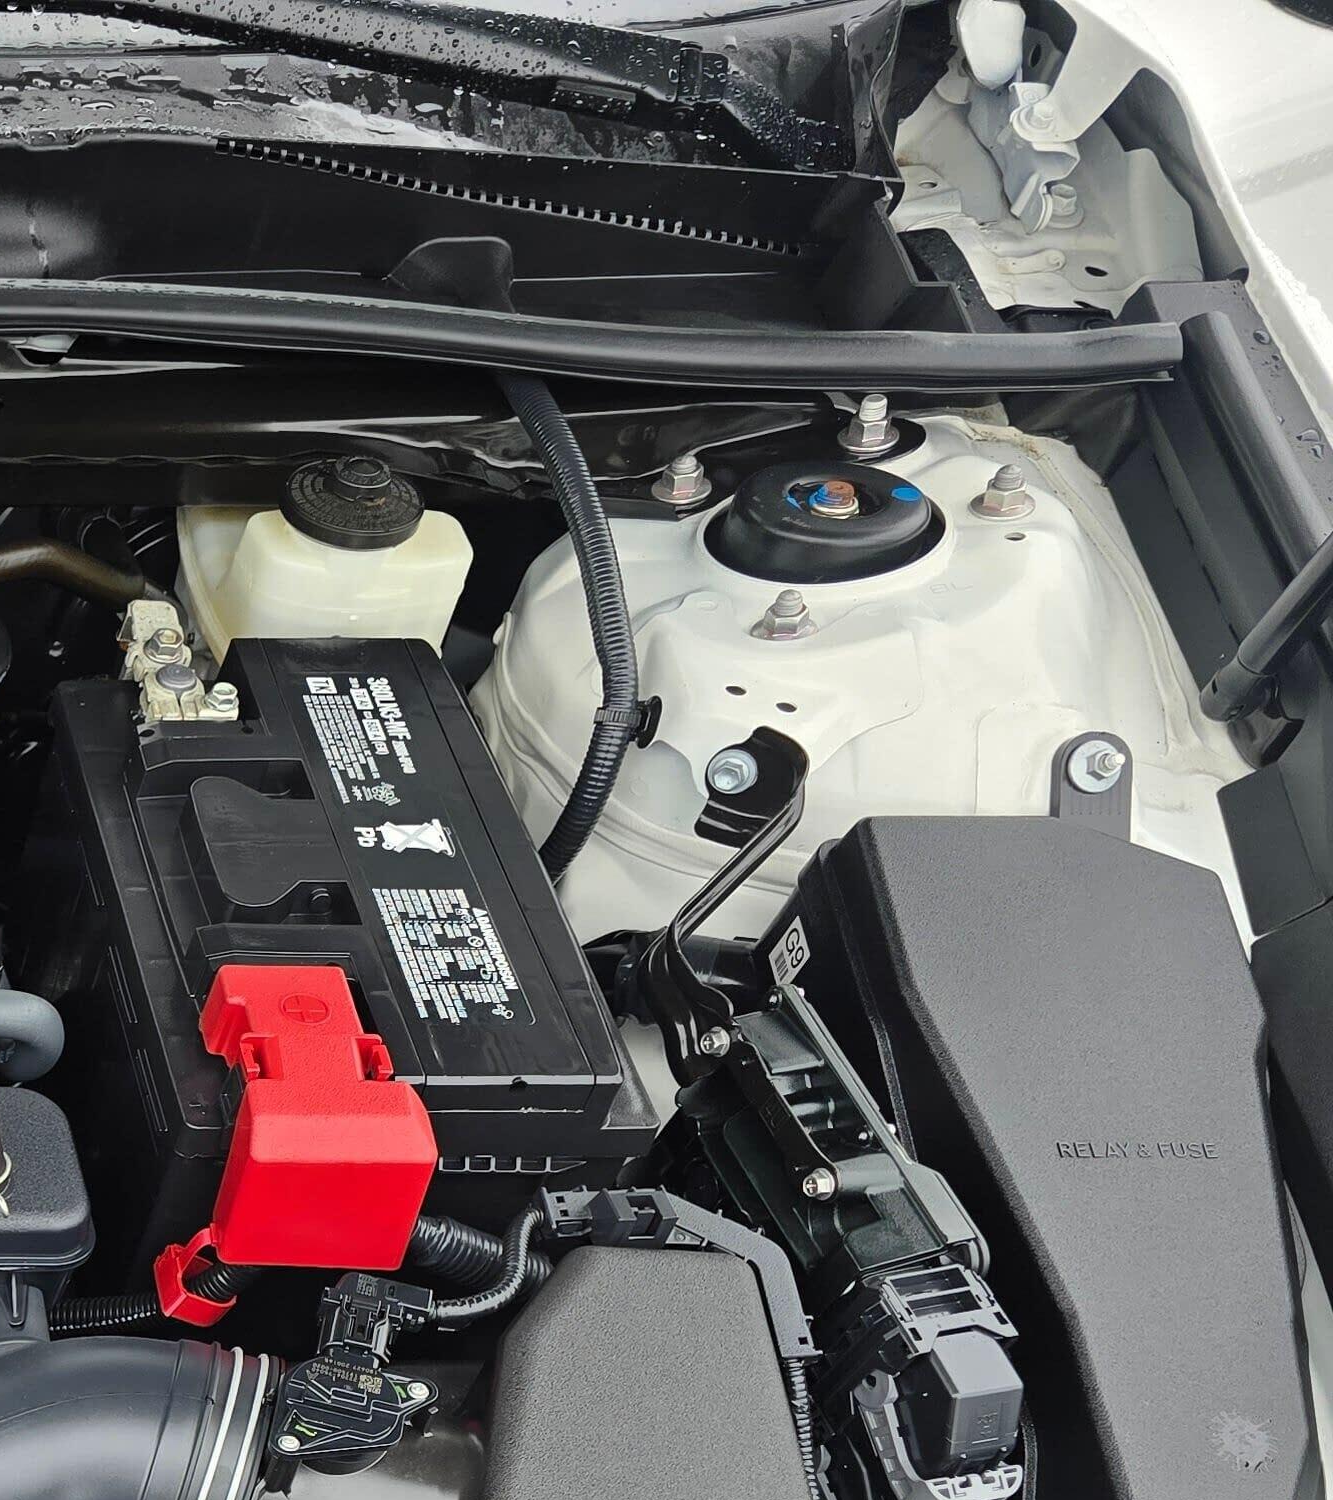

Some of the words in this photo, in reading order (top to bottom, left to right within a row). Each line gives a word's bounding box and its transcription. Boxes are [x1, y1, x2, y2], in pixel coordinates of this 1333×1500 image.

[366, 677, 411, 739] 380LN3-MF
[353, 826, 373, 848] Pb
[785, 928, 805, 968] G9
[1056, 1142, 1129, 1159] RELAY
[1137, 1142, 1152, 1159] &
[1157, 1142, 1218, 1159] FUSE
